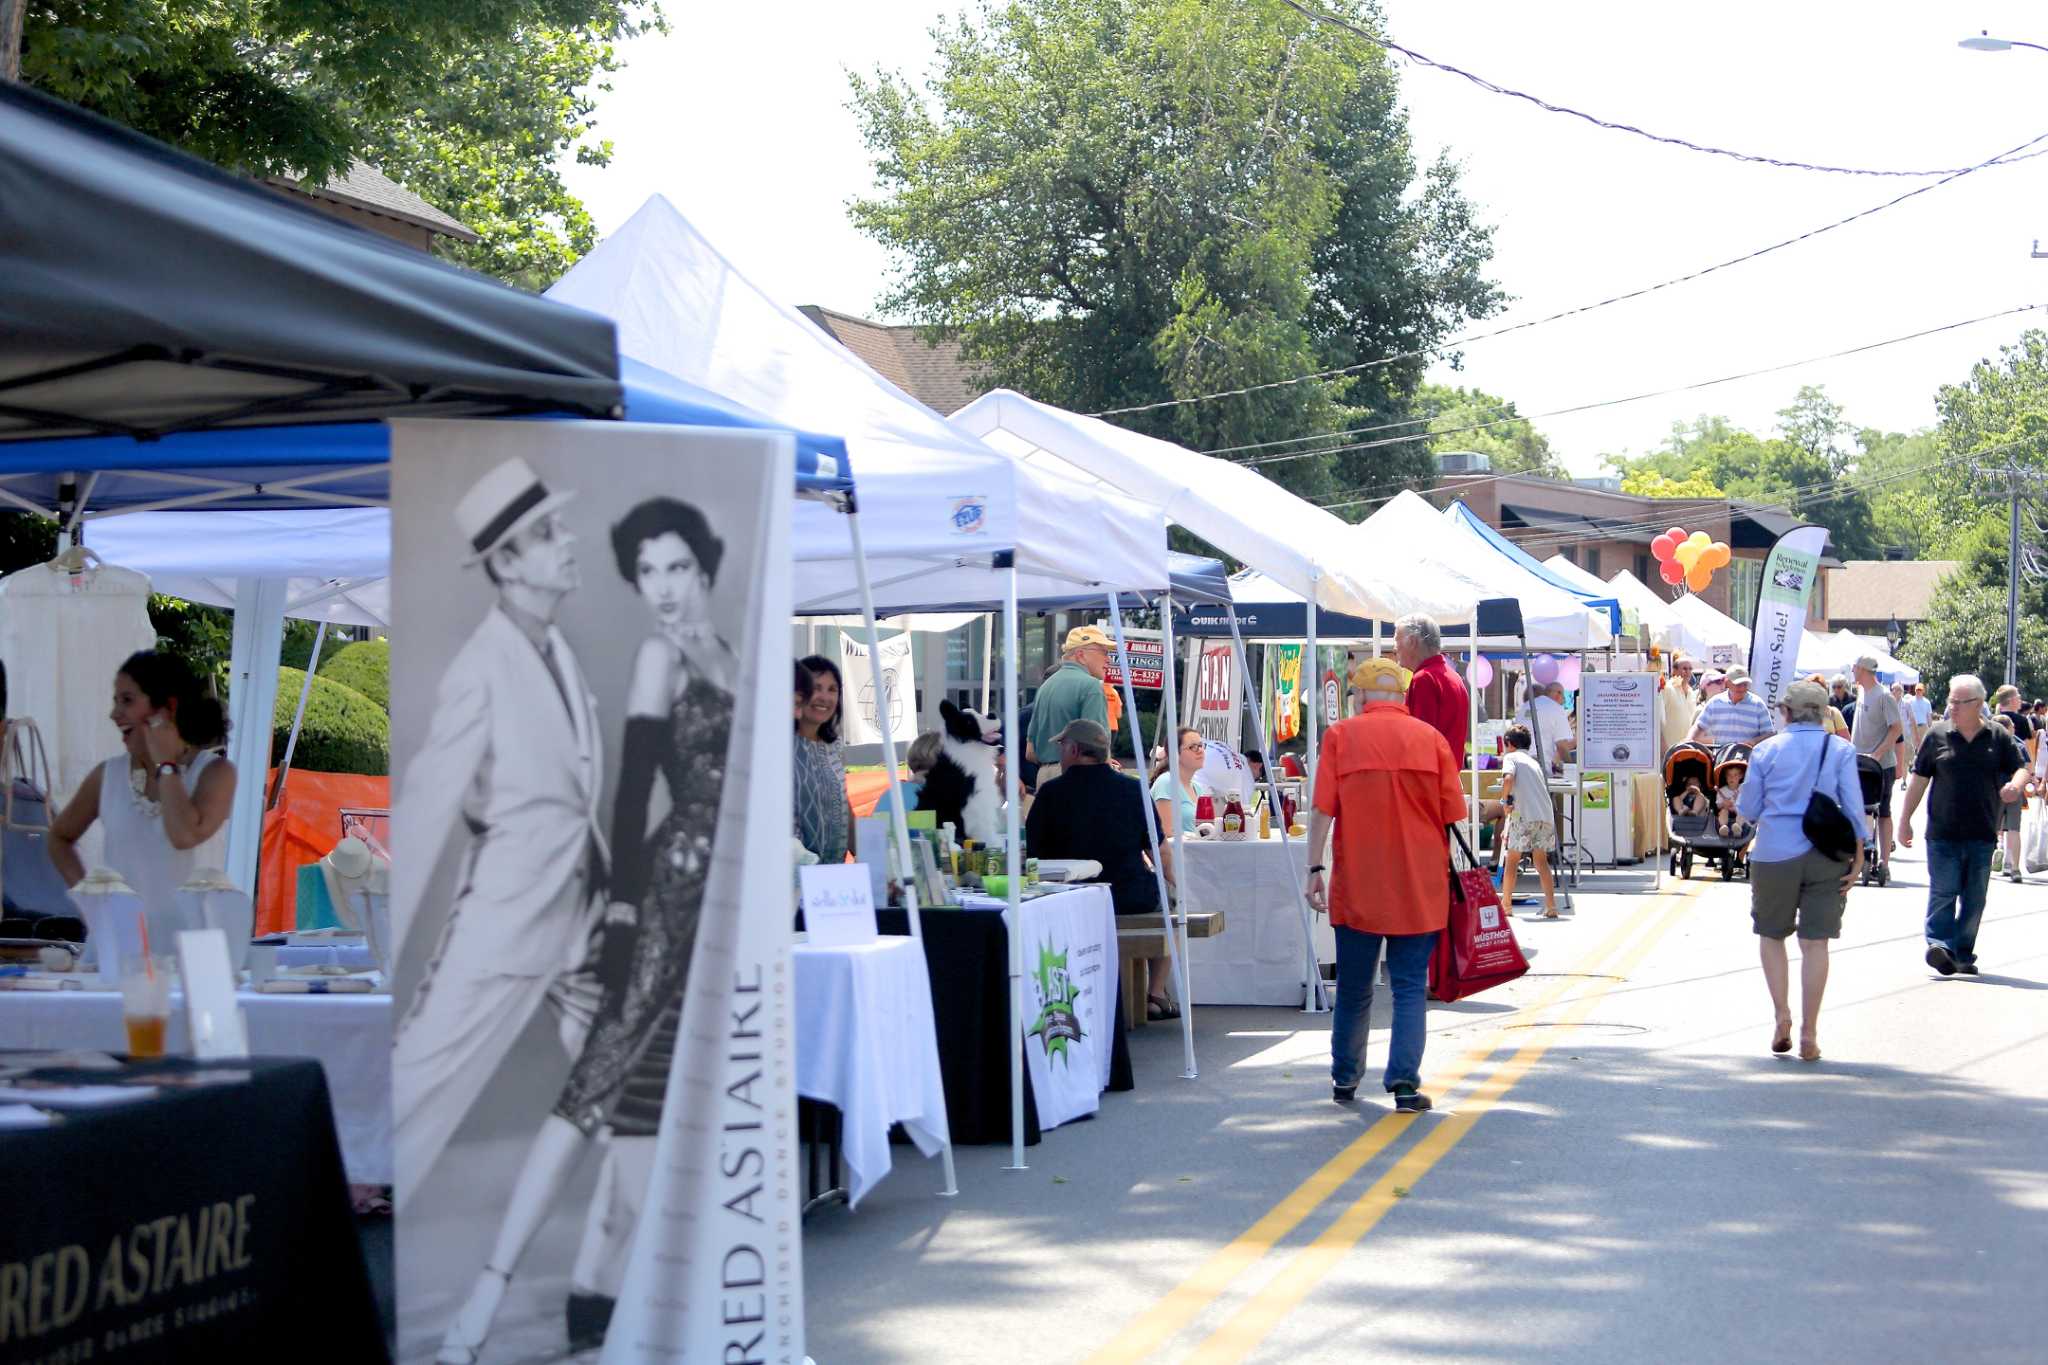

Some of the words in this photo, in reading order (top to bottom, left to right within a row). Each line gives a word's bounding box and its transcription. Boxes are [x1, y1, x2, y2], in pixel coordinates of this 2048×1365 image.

[1776, 553, 1808, 569] Renewal
[1770, 612, 1789, 653] Sale!
[1202, 654, 1230, 701] HAN
[775, 1112, 790, 1200] DANCE
[0, 1243, 90, 1343] RED
[95, 1193, 257, 1310] ASTAIRE
